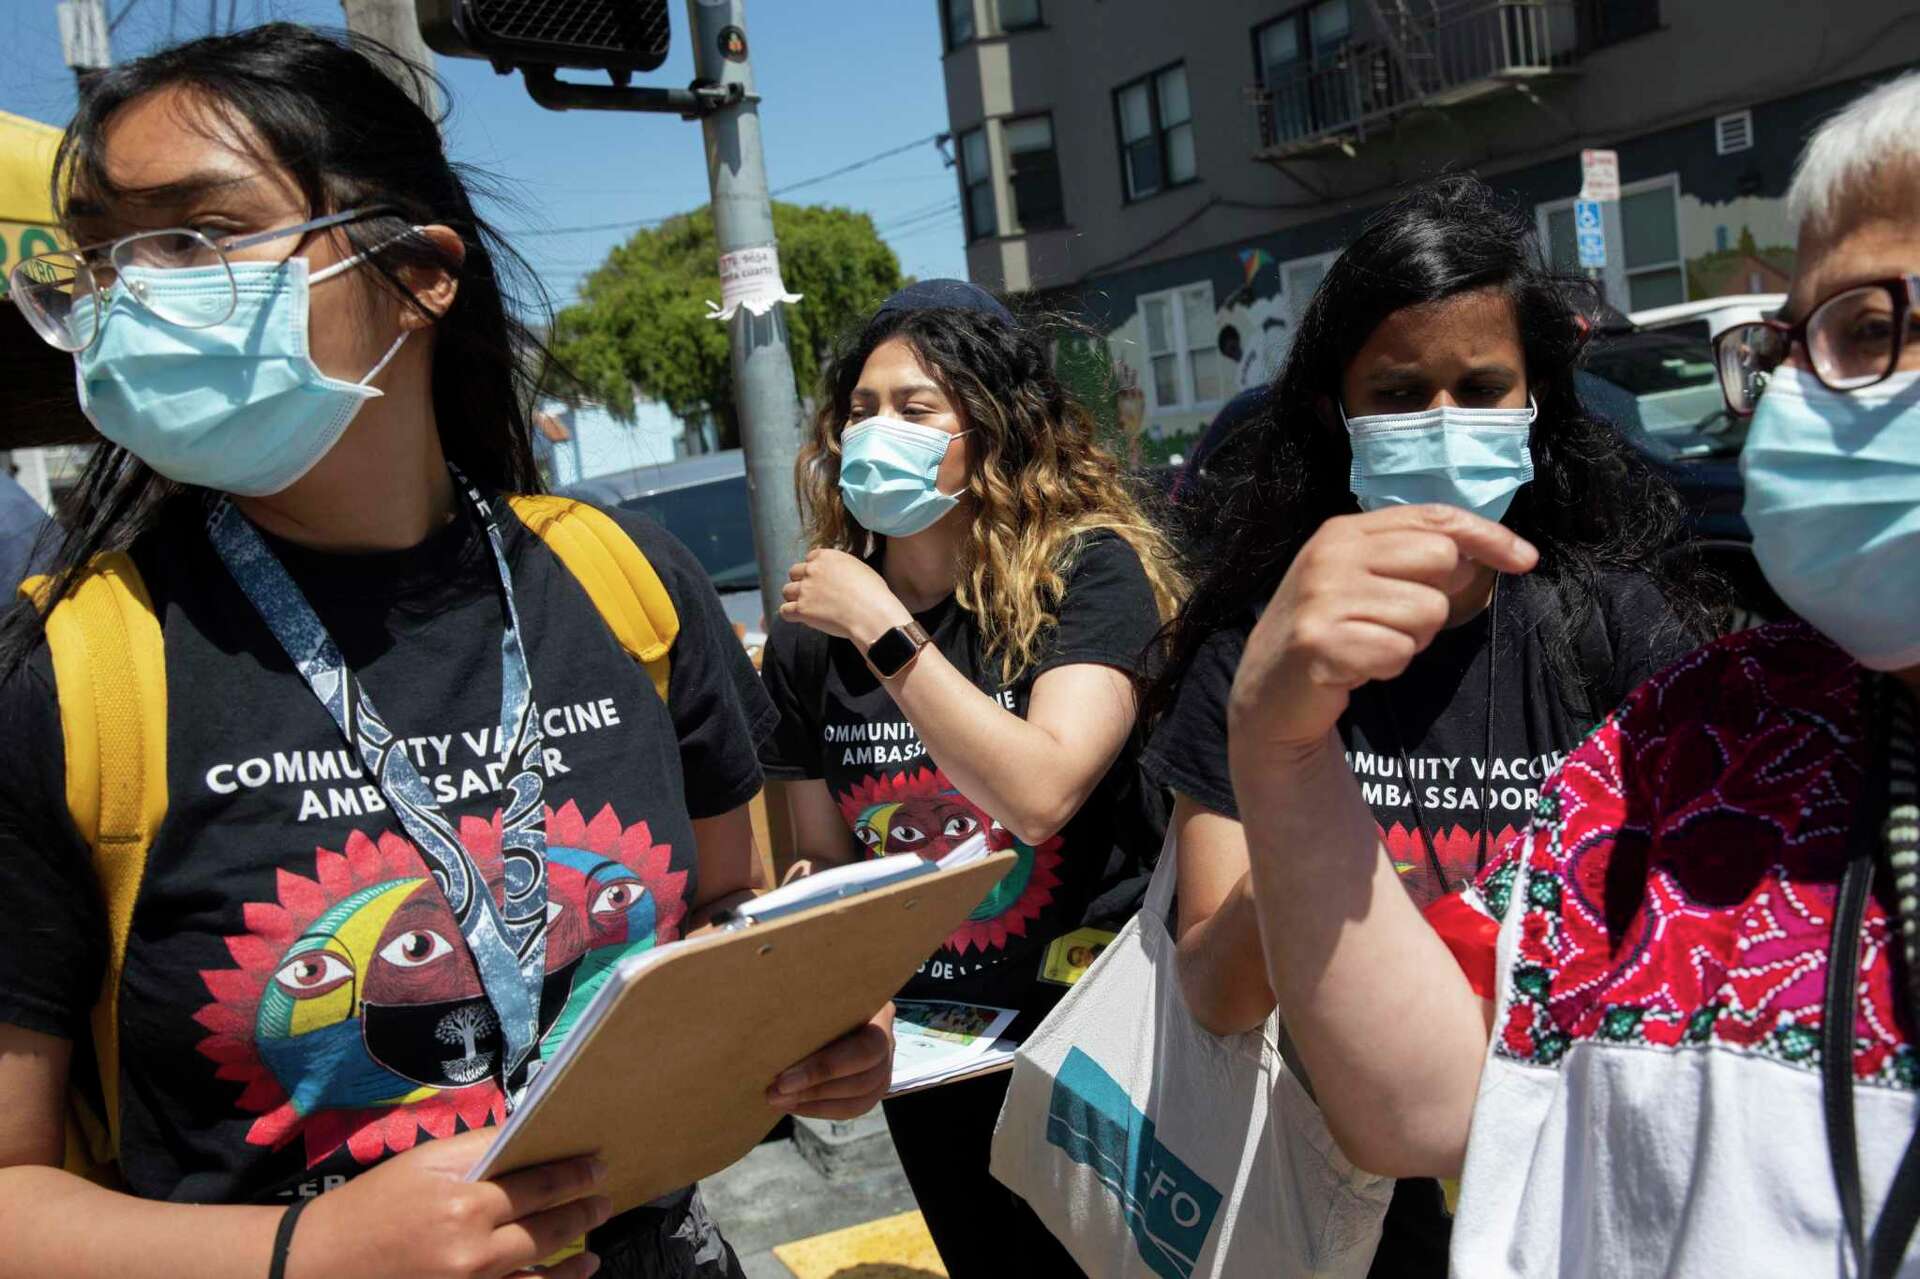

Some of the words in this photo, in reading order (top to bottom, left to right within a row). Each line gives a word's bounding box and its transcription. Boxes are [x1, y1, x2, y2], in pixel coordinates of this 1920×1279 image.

[206, 734, 452, 795] COMMUTY
[461, 697, 621, 758] VCINE
[1345, 750, 1461, 780] MUNITY
[297, 747, 572, 822] AMBSADR
[1144, 1159, 1200, 1228] FO
